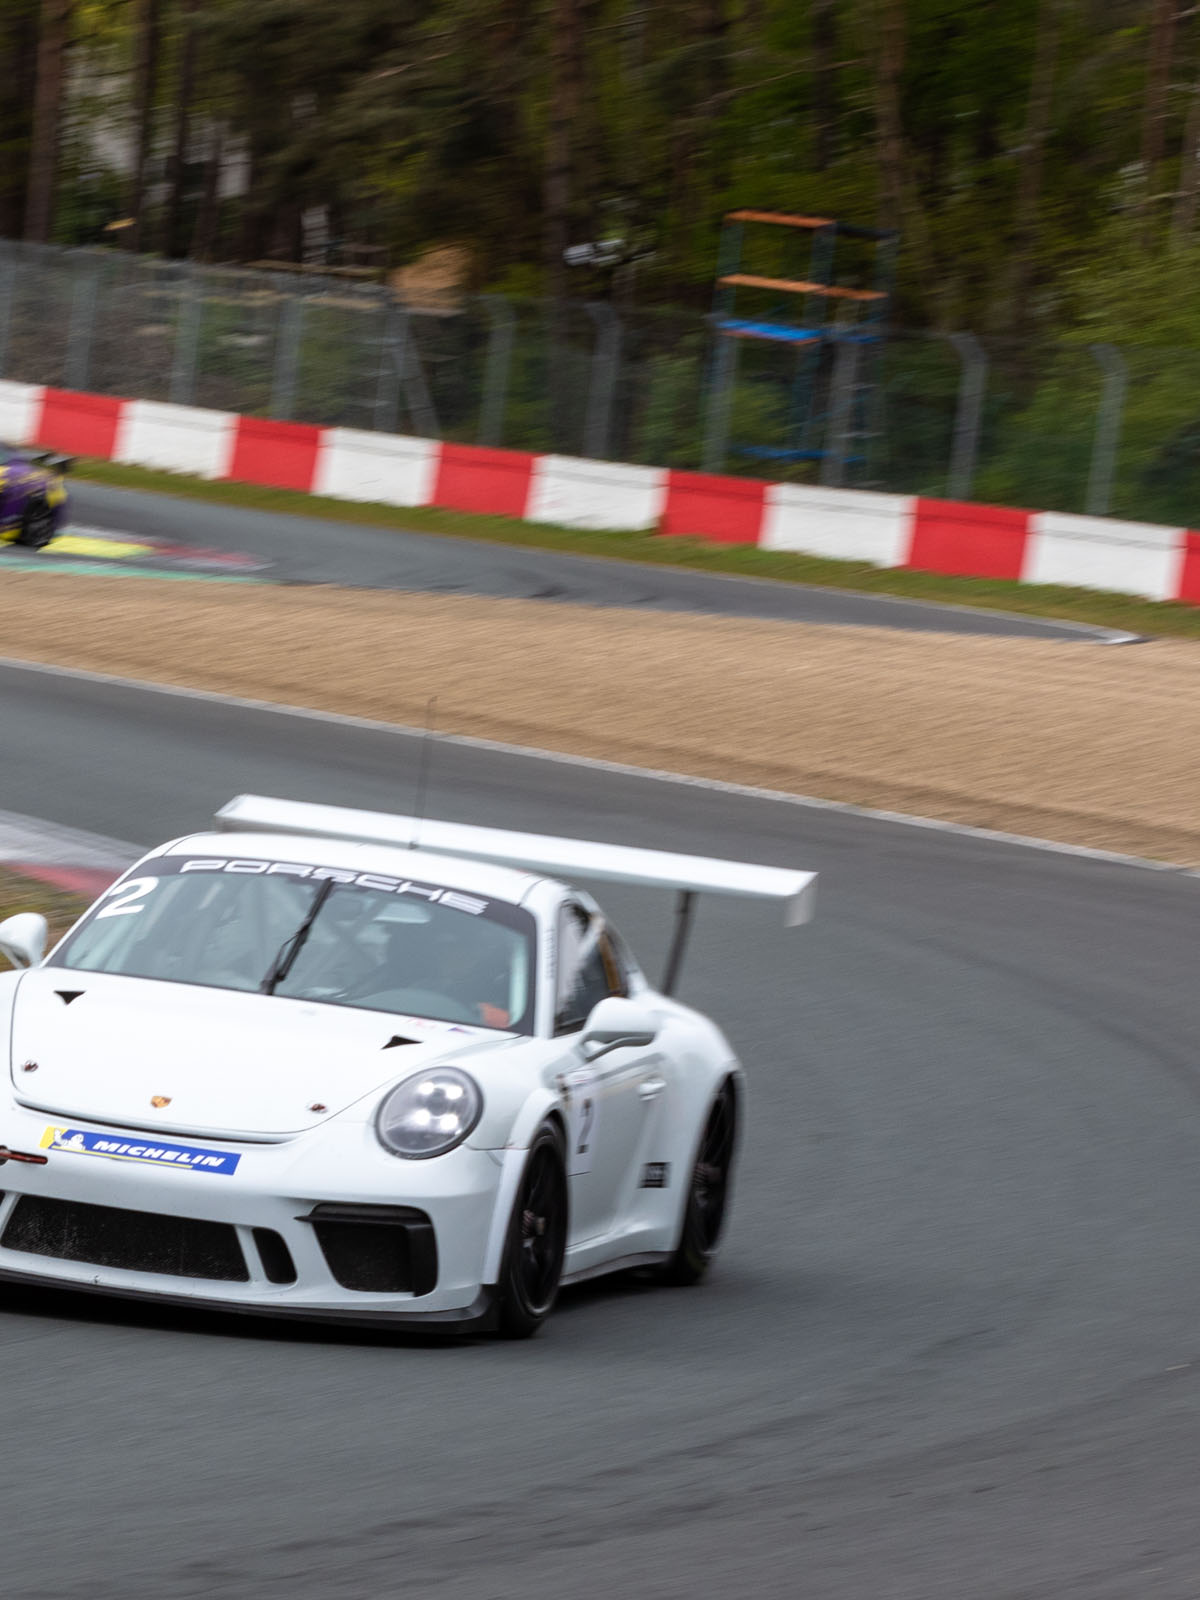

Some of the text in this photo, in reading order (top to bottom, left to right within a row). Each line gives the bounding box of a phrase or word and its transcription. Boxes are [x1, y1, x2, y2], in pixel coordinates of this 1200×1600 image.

[94, 876, 159, 920] 2
[179, 859, 489, 915] PORSCHE
[92, 1140, 226, 1168] MICHELIN
